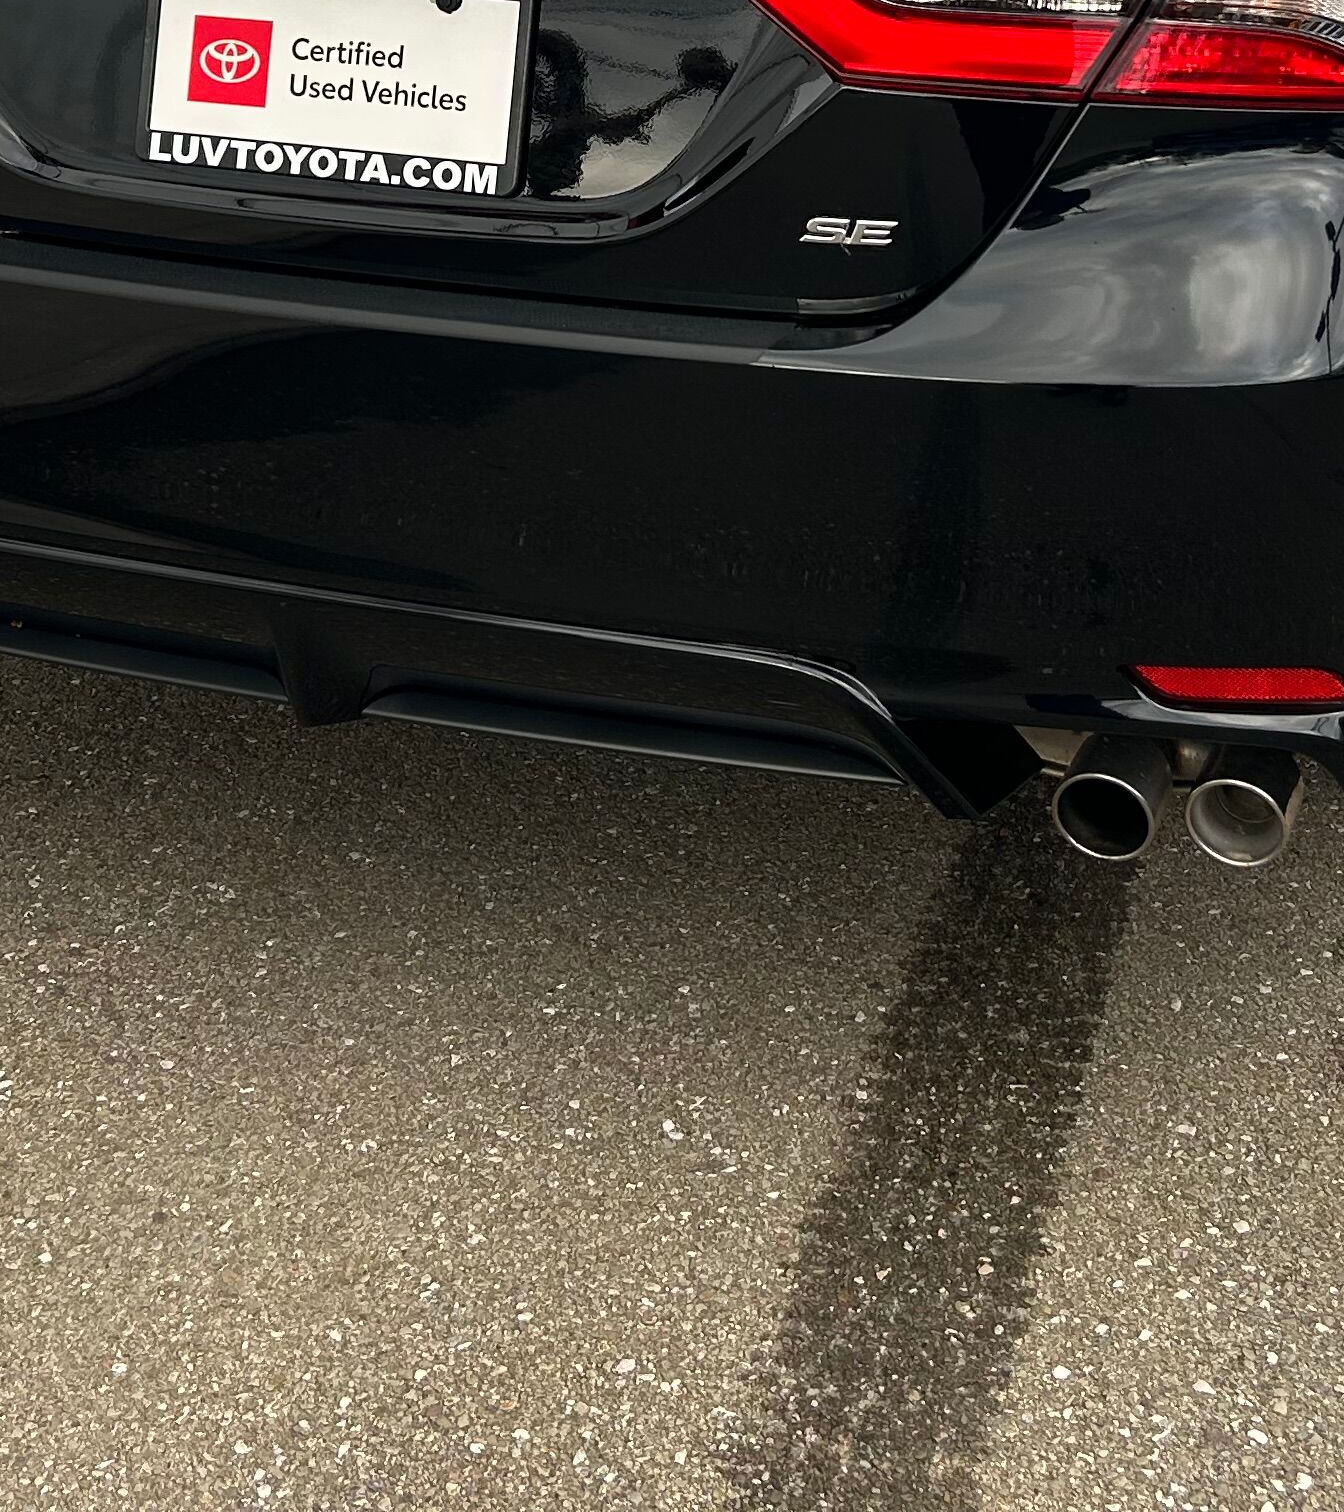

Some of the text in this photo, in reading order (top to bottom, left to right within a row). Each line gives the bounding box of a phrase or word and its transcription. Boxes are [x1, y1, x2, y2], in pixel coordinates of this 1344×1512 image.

[291, 38, 405, 69] Certified
[289, 74, 468, 112] Used Vehicles
[148, 131, 499, 196] LUVTOYOTA.COM
[798, 216, 900, 247] SE
